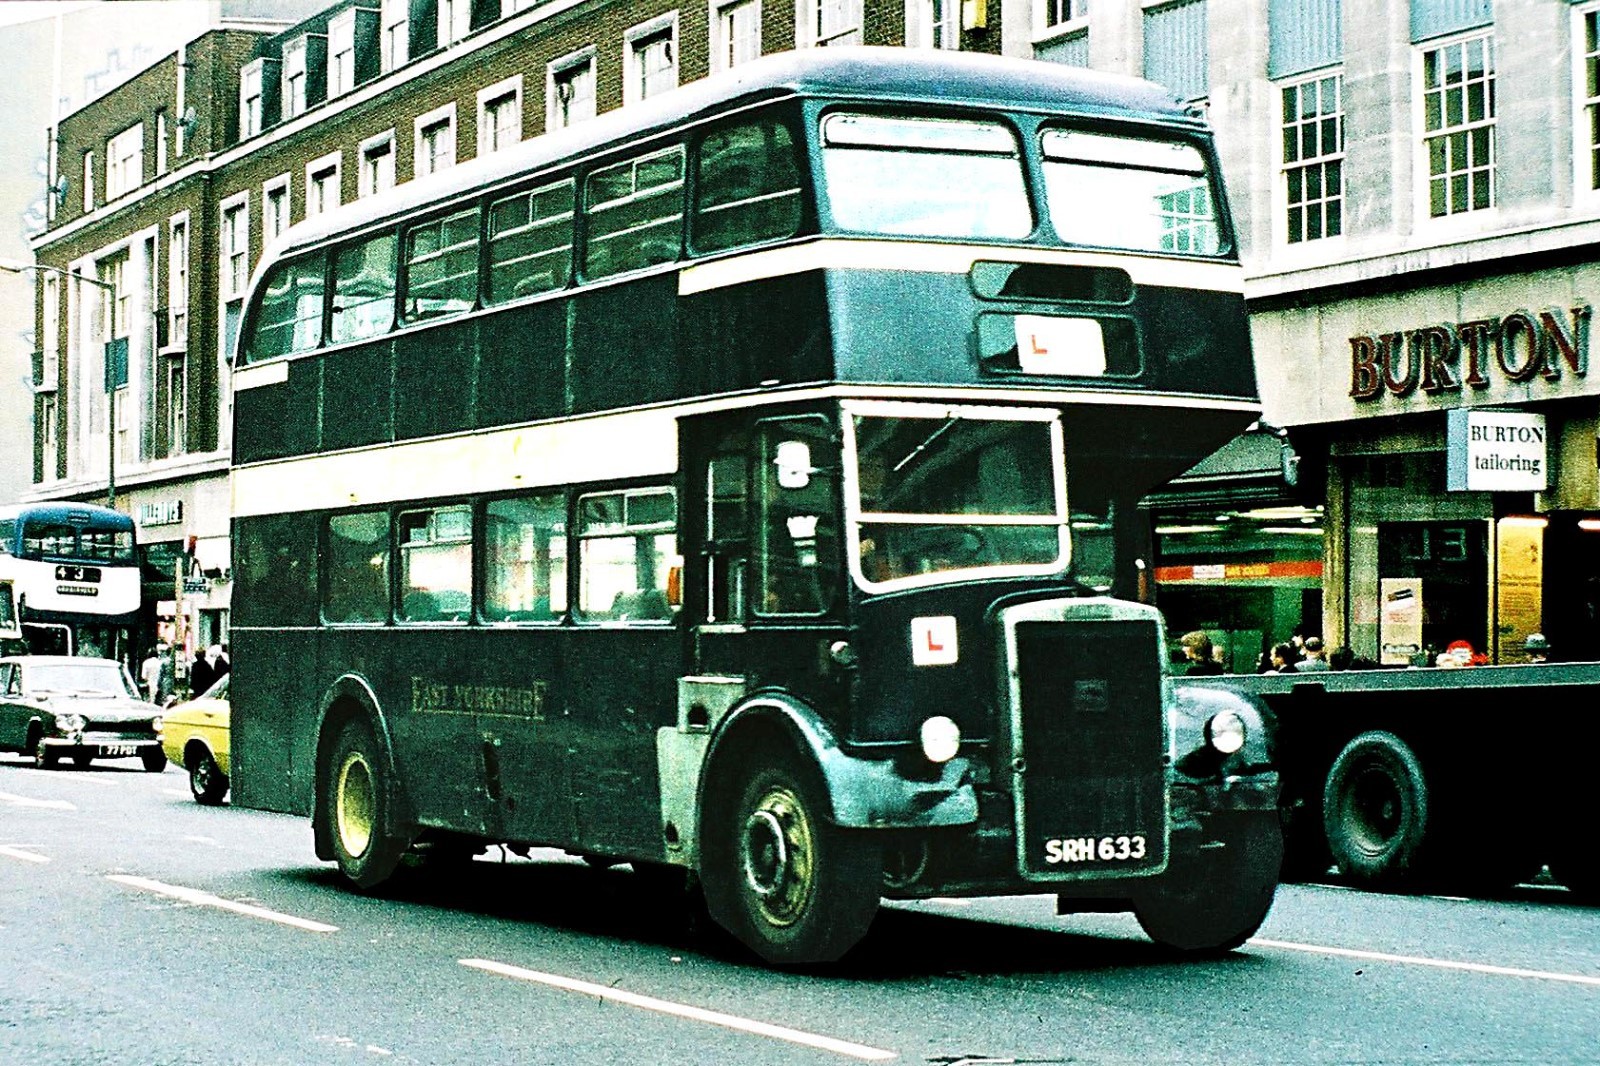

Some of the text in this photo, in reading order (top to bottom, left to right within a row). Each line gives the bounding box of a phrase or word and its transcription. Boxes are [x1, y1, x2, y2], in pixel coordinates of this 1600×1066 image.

[1031, 334, 1048, 354] L
[1349, 304, 1592, 397] BURTON
[1471, 425, 1544, 442] BURTON
[1475, 454, 1541, 475] tailoring
[927, 629, 944, 651] L
[1045, 835, 1146, 864] SRH 633
